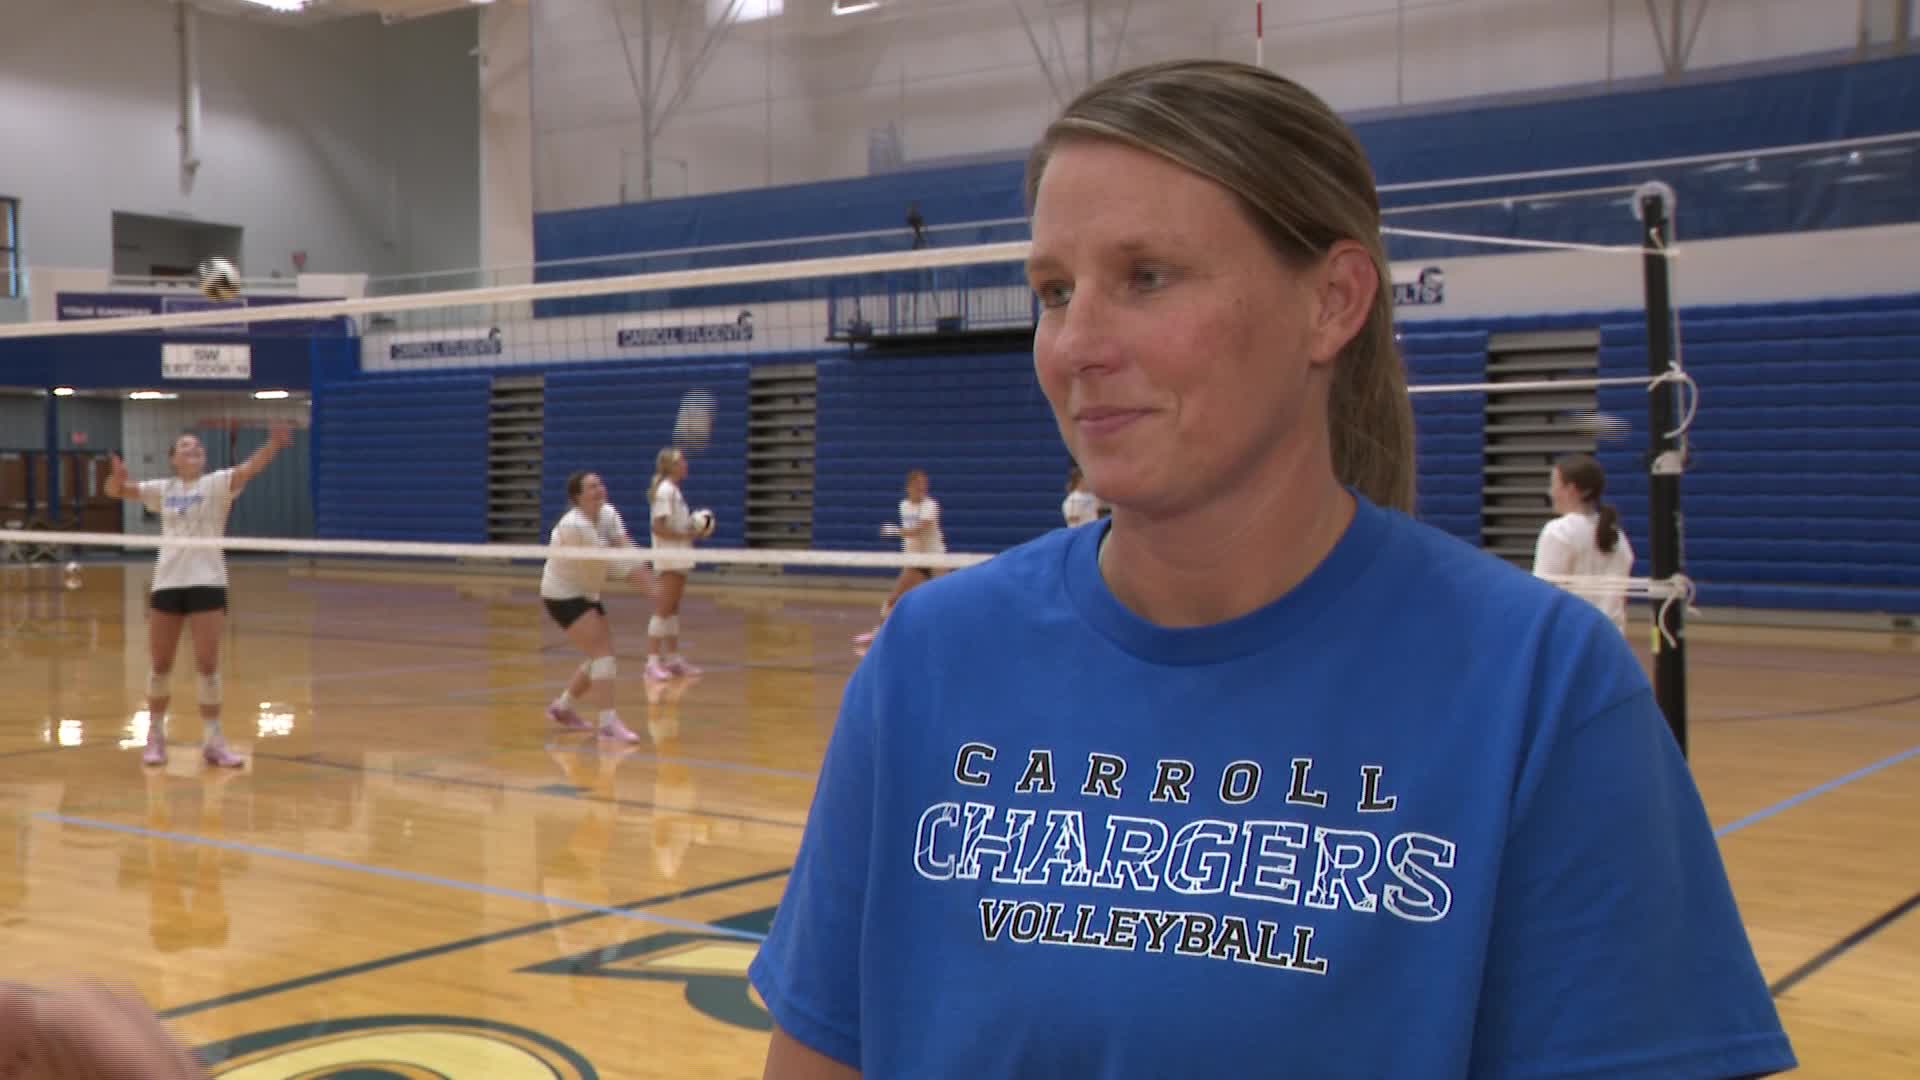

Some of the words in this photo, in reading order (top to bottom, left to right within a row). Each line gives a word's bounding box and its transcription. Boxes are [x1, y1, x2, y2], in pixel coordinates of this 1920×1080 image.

[953, 742, 1397, 813] CARROLL
[913, 801, 1457, 922] CHARGERS
[979, 898, 1328, 975] VOLLEYBALL
